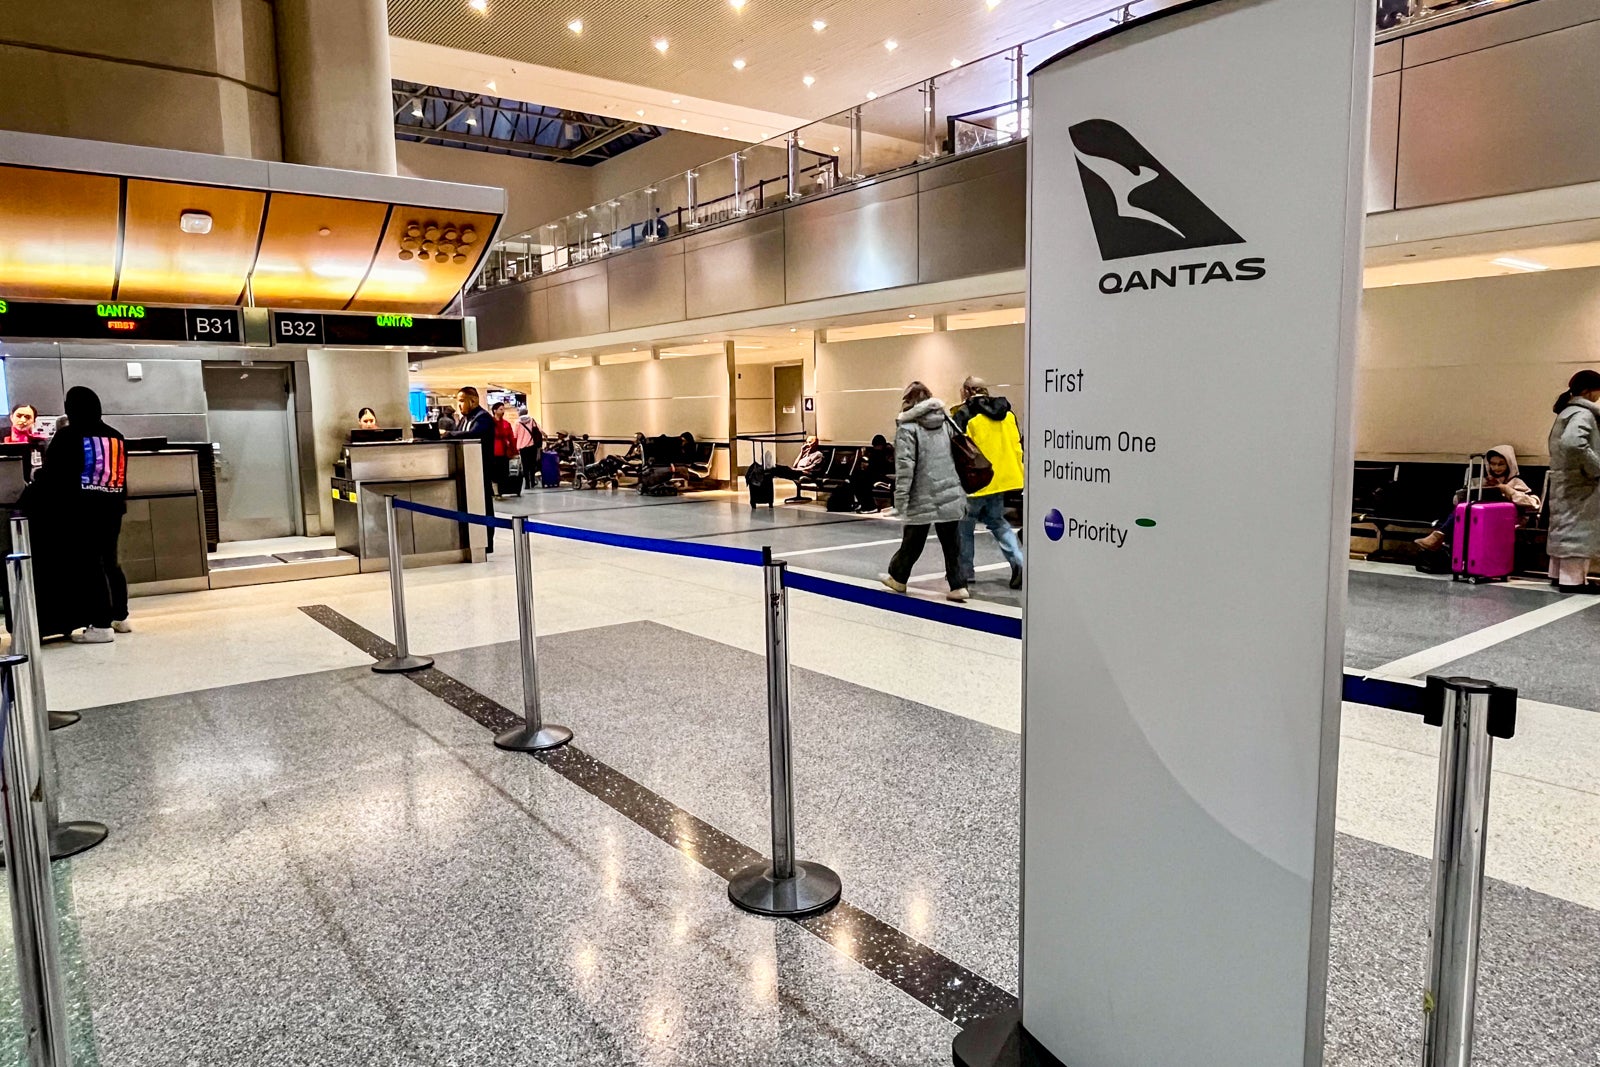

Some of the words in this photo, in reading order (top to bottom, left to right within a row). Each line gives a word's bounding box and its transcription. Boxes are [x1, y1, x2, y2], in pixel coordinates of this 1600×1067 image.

[1098, 257, 1266, 295] QANTAS
[97, 304, 145, 318] QANTAS
[376, 314, 413, 328] QANTAS
[107, 321, 135, 329] FIRST
[196, 317, 233, 334] B31
[280, 320, 317, 337] B32
[1045, 368, 1084, 392] First
[1044, 429, 1111, 451] Platinum
[1118, 431, 1156, 452] One
[1044, 459, 1110, 483] Platinum
[1068, 517, 1128, 548] Priority
